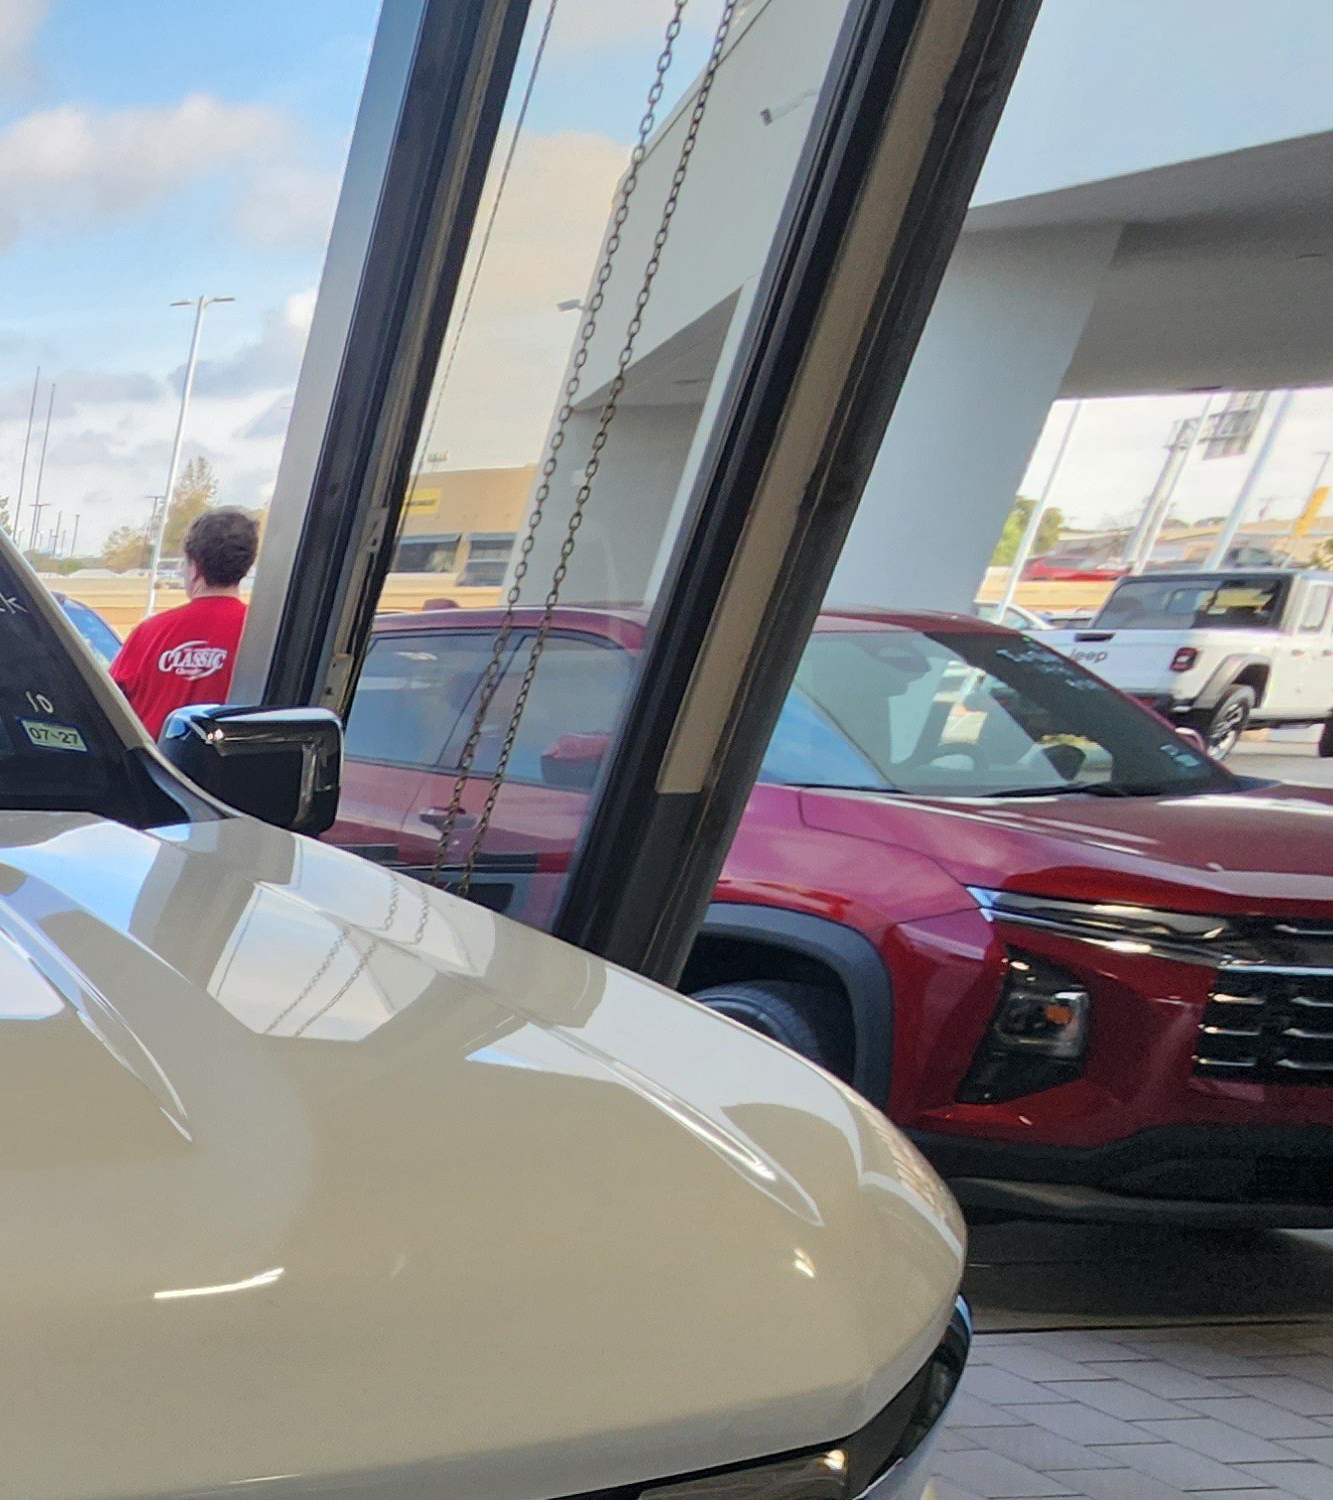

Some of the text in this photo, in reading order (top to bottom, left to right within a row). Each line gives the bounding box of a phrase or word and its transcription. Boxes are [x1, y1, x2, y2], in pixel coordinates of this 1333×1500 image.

[158, 649, 227, 673] CLASSIC
[26, 691, 53, 713] 10
[29, 727, 78, 744] 07-27
